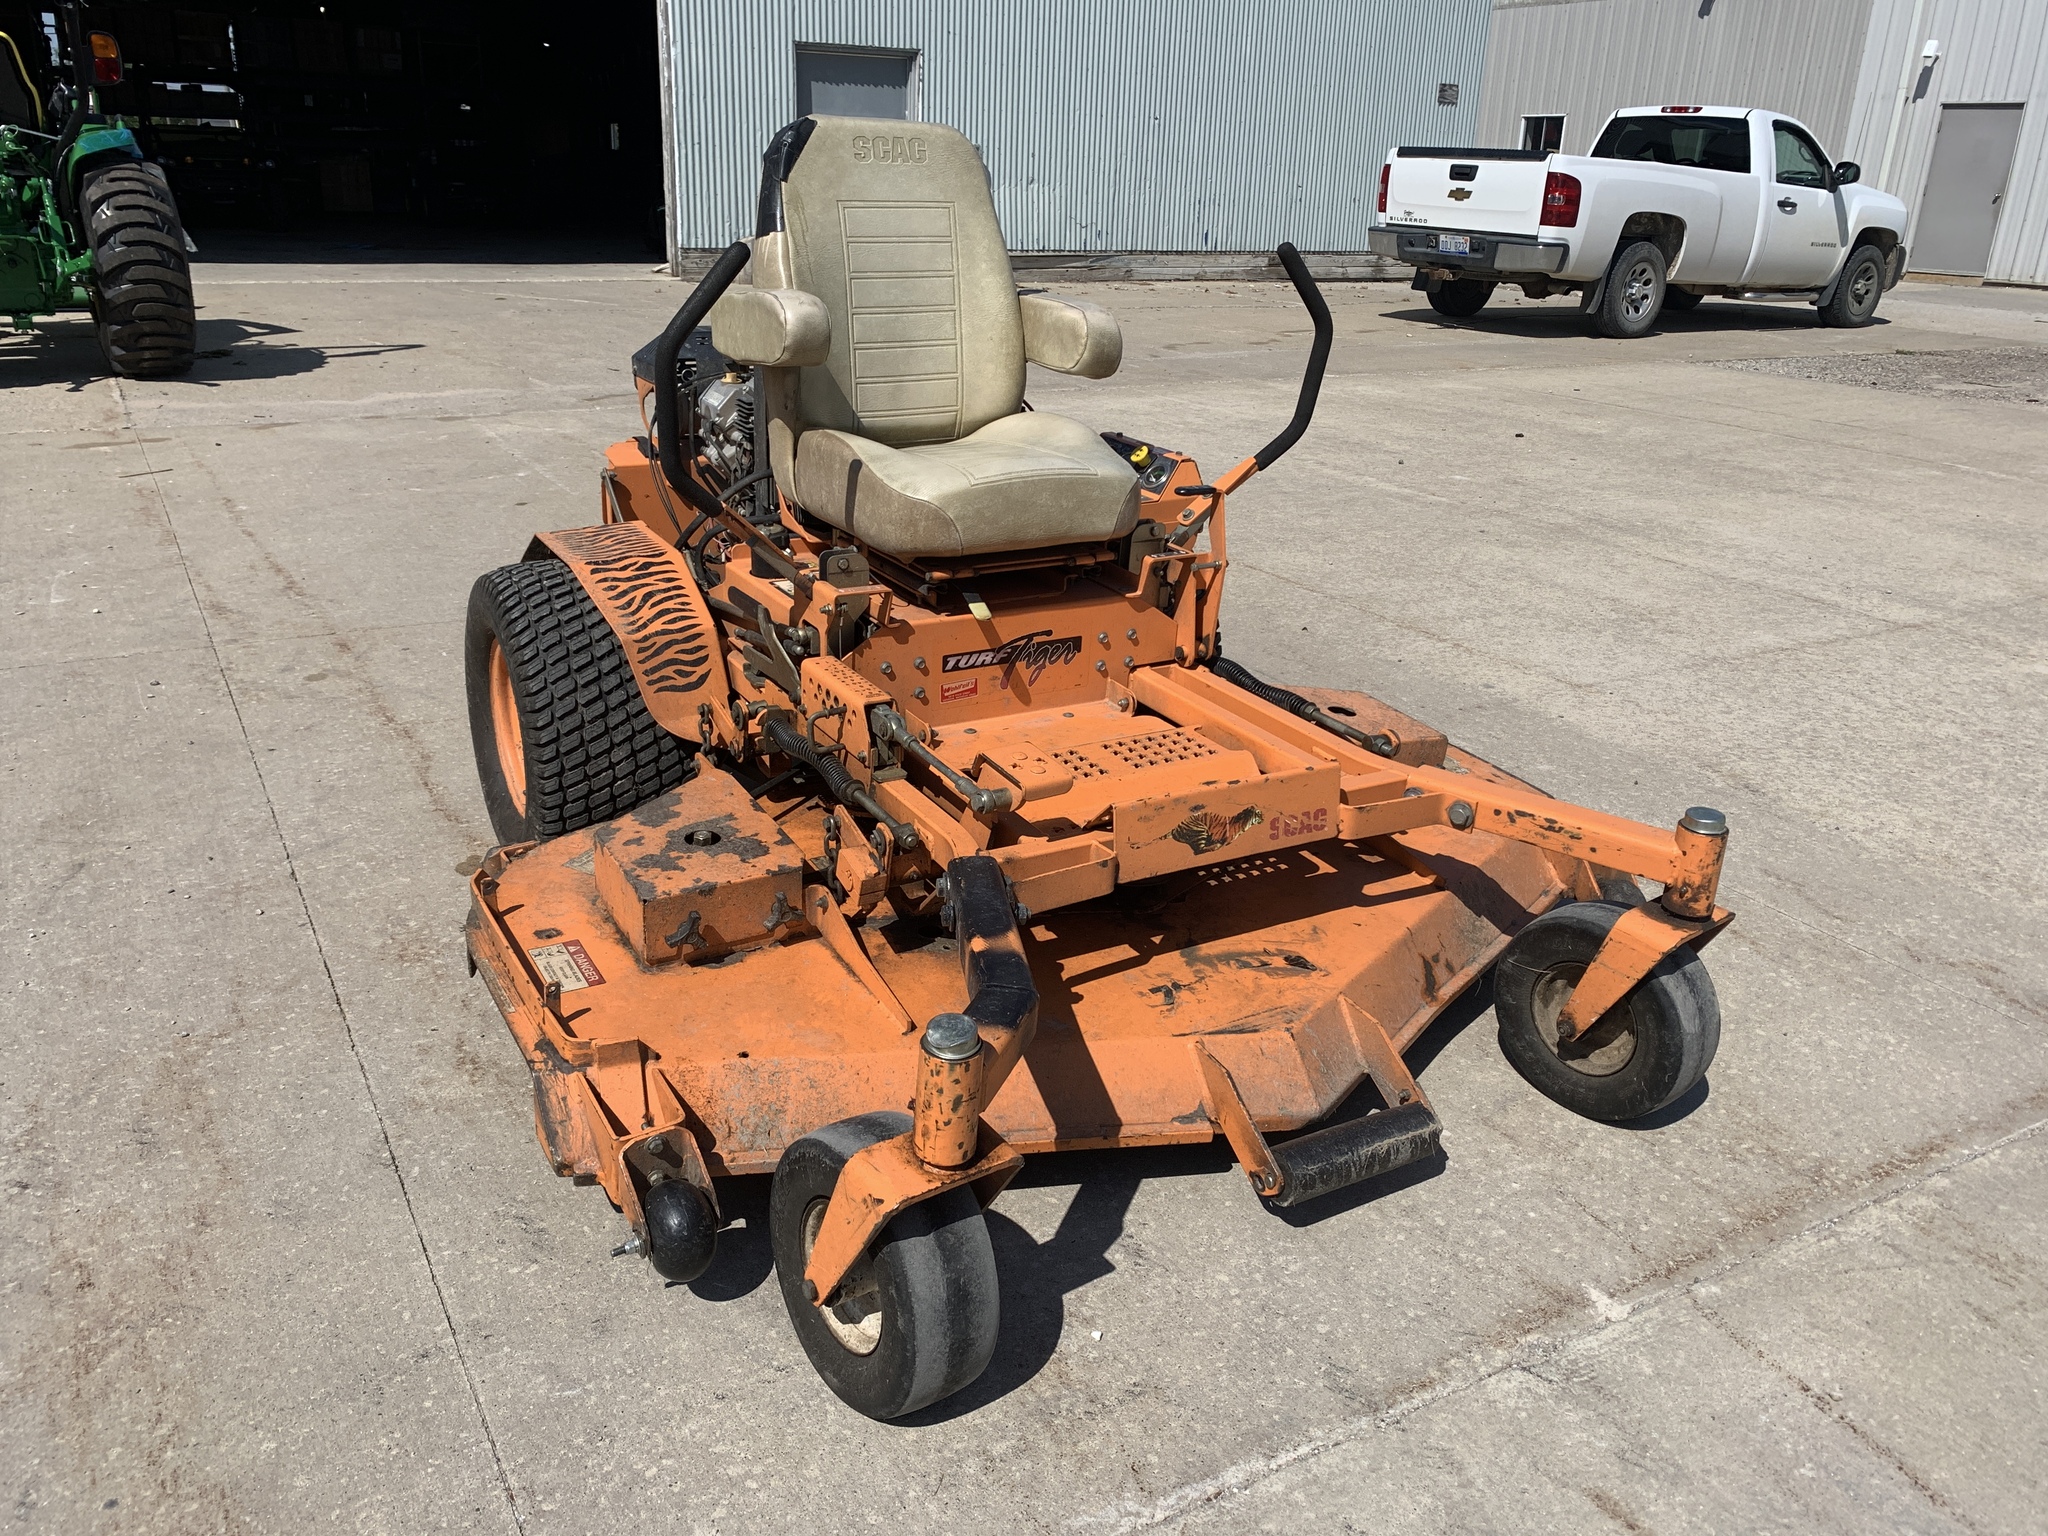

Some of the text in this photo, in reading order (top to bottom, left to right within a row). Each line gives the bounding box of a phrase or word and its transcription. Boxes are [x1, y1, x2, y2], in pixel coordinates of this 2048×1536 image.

[852, 136, 928, 165] SCAG
[1389, 215, 1428, 224] SILVERADO
[944, 629, 1078, 690] TURF Tiger
[1269, 808, 1328, 840] SCAG
[573, 953, 599, 982] DANGER
